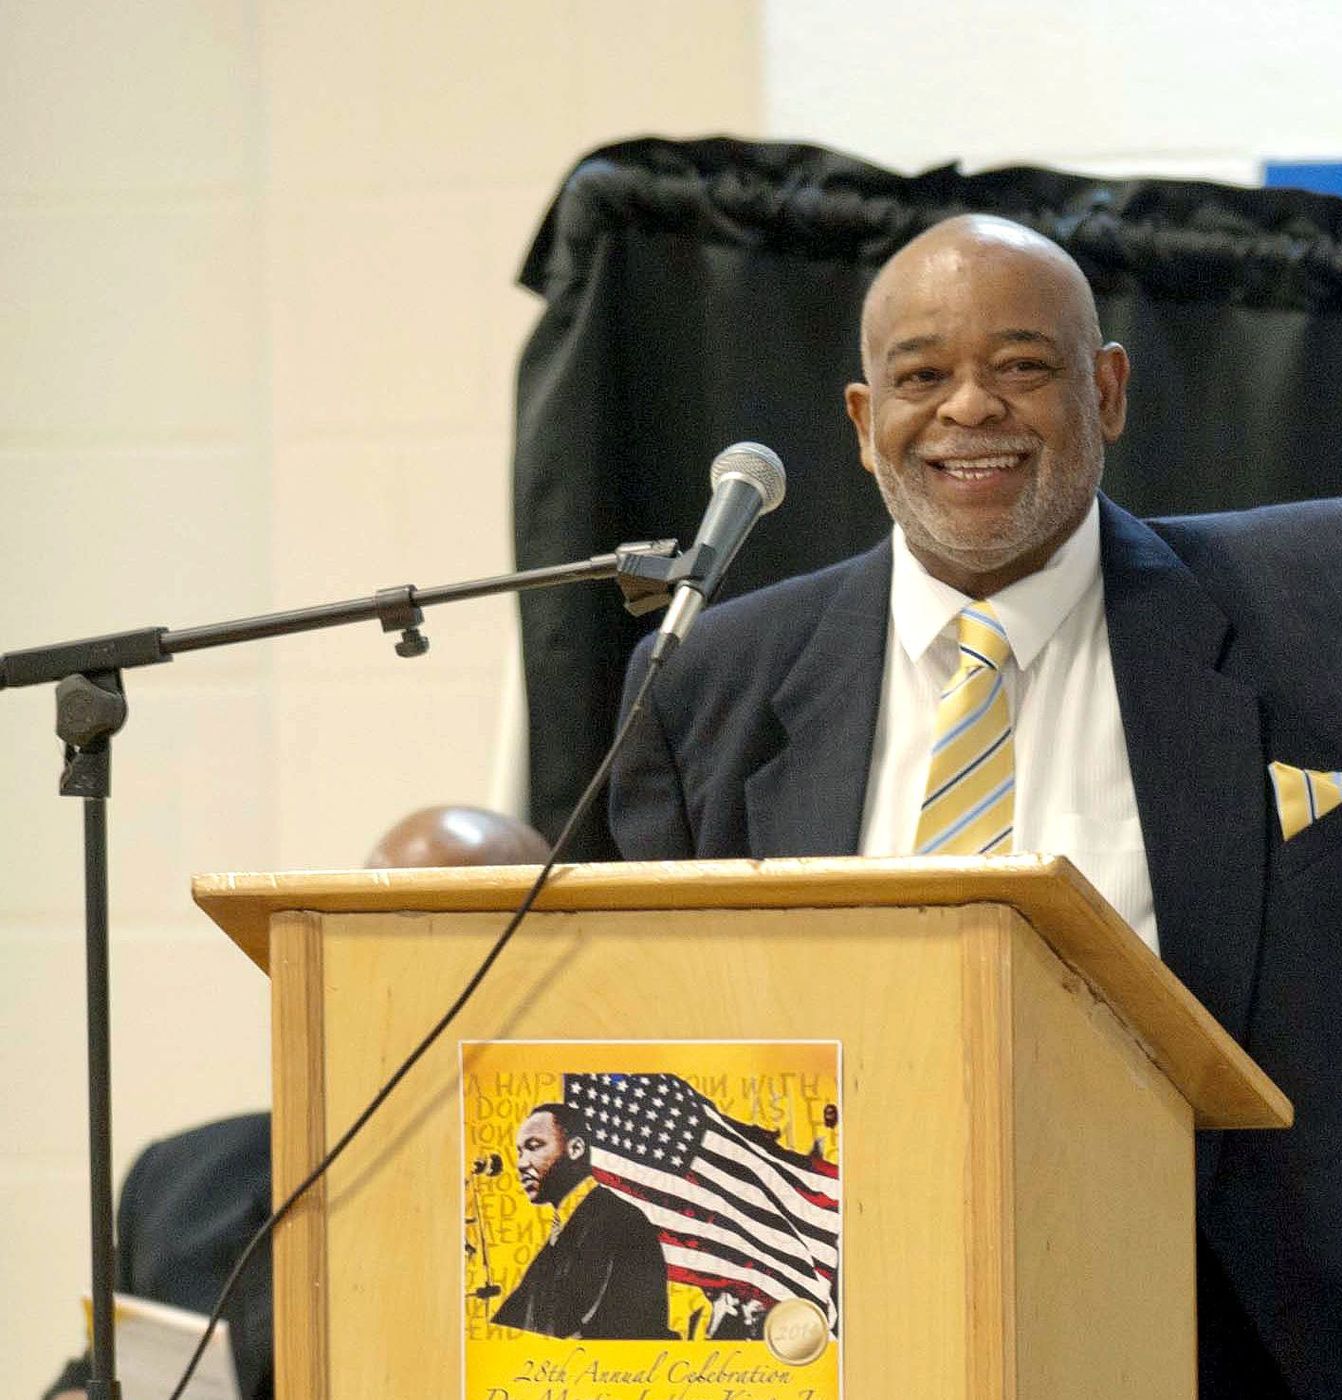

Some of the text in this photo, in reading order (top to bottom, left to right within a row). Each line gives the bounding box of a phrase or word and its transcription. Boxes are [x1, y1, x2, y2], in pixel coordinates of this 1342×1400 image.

[513, 1347, 791, 1385] 28th Annual Celebration
